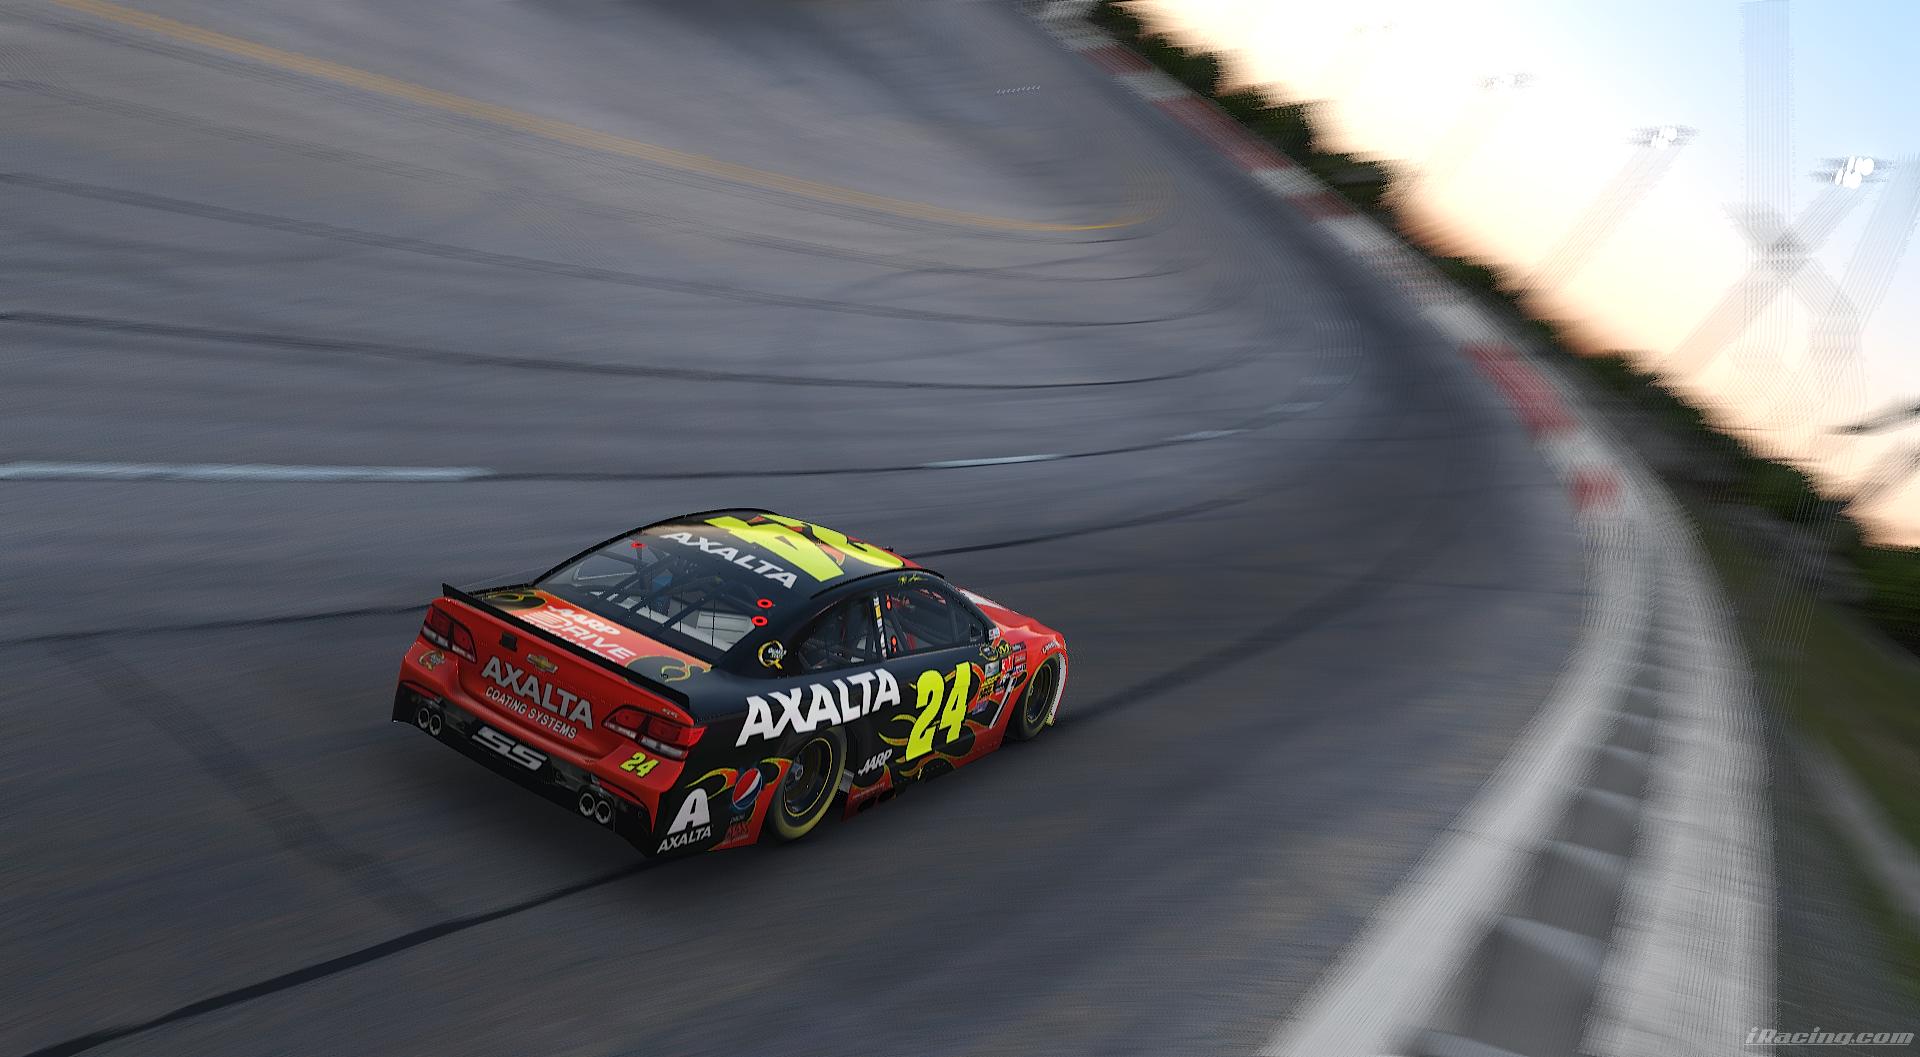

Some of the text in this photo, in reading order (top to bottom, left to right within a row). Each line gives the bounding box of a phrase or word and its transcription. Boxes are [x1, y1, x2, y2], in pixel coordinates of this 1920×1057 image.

[659, 531, 799, 589] AXALTA
[547, 605, 621, 635] AARP
[481, 656, 593, 730] AXALTA
[485, 686, 578, 740] COATING SYSTEMS
[734, 667, 901, 748] AXALTA
[905, 661, 971, 762] 24
[471, 725, 548, 771] SS
[619, 751, 659, 779] 24
[857, 748, 893, 776] AARP
[656, 825, 712, 855] AXALTA
